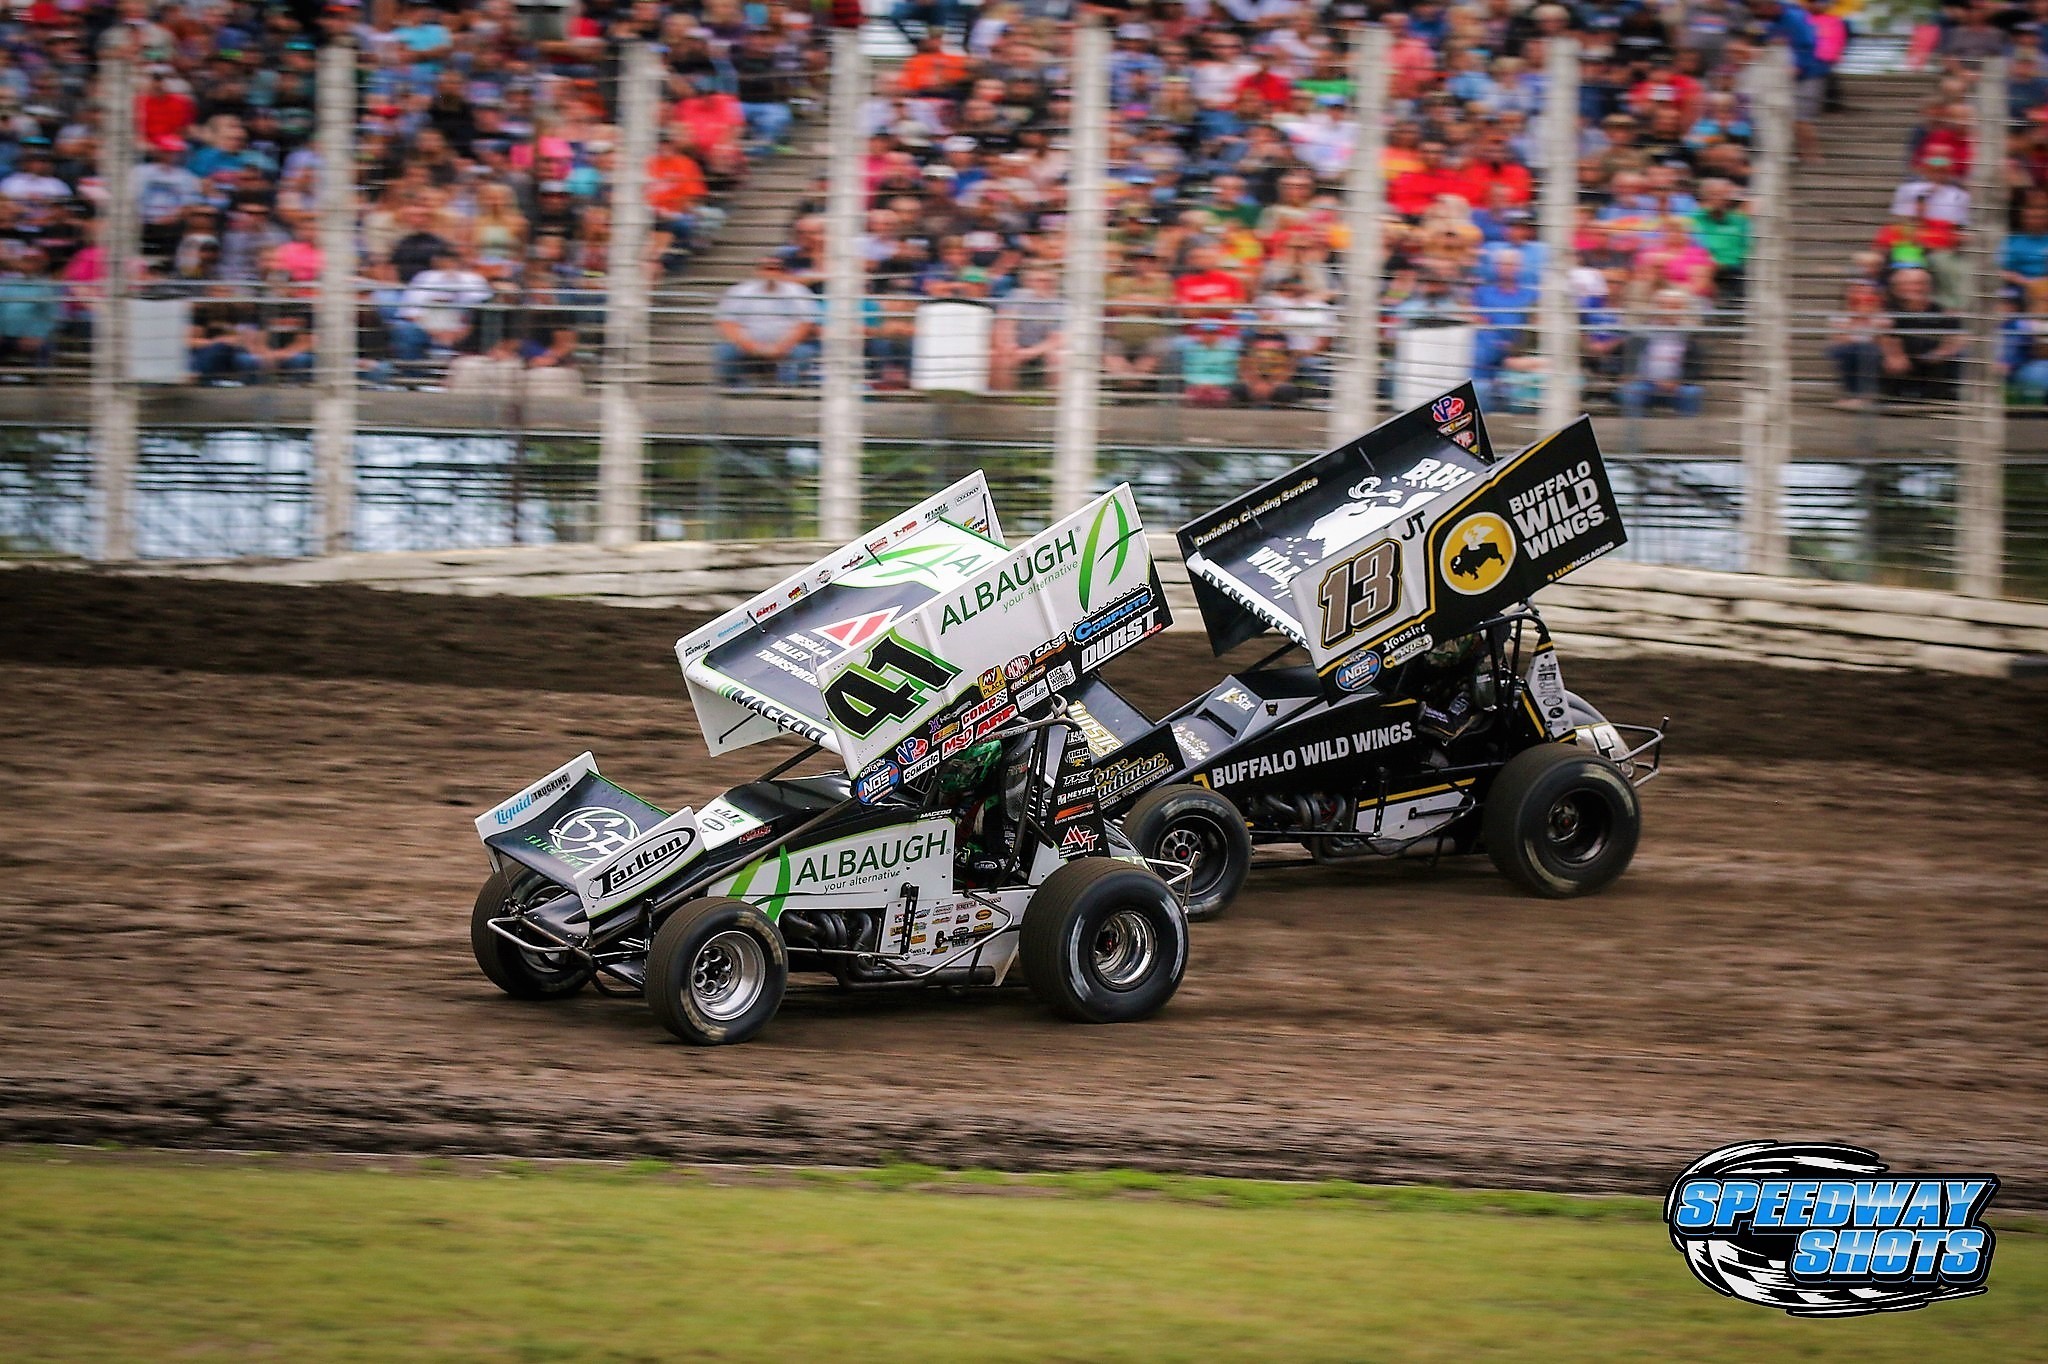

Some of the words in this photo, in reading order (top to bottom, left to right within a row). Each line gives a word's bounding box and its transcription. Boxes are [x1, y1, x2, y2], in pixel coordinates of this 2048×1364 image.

[1194, 517, 1240, 547] Danielle's
[1280, 477, 1319, 502] Service
[1508, 460, 1592, 514] BUFFALO
[1513, 478, 1600, 540] WILD
[1401, 510, 1426, 541] JT
[1522, 503, 1606, 561] WINGS
[940, 529, 1078, 636] ALBAUGH
[1002, 588, 1026, 613] your
[1026, 559, 1080, 595] alternative
[1318, 537, 1403, 650] 13
[1073, 593, 1151, 642] COMPLETE
[1081, 607, 1159, 667] DURST
[770, 639, 813, 662] VALLEY
[1006, 655, 1030, 678] ACME
[1034, 632, 1068, 658] CASE
[1344, 656, 1372, 683] NOS
[824, 634, 959, 738] 41
[962, 695, 997, 725] COMP
[983, 679, 1006, 696] PLACE
[729, 689, 828, 746] MACEDO
[943, 727, 972, 754] MSD
[976, 704, 1017, 737] ARP
[863, 765, 891, 796] NOS
[904, 753, 940, 780] COMETIC
[1212, 749, 1297, 789] BUFFALO
[1300, 735, 1350, 767] WILD
[1352, 721, 1413, 754] WINGS
[495, 792, 534, 825] Liquid
[532, 773, 570, 801] TRUCKING
[592, 833, 682, 894] Tarlton
[795, 828, 949, 886] ALBAUGH
[824, 880, 847, 893] your
[849, 870, 900, 886] alternative
